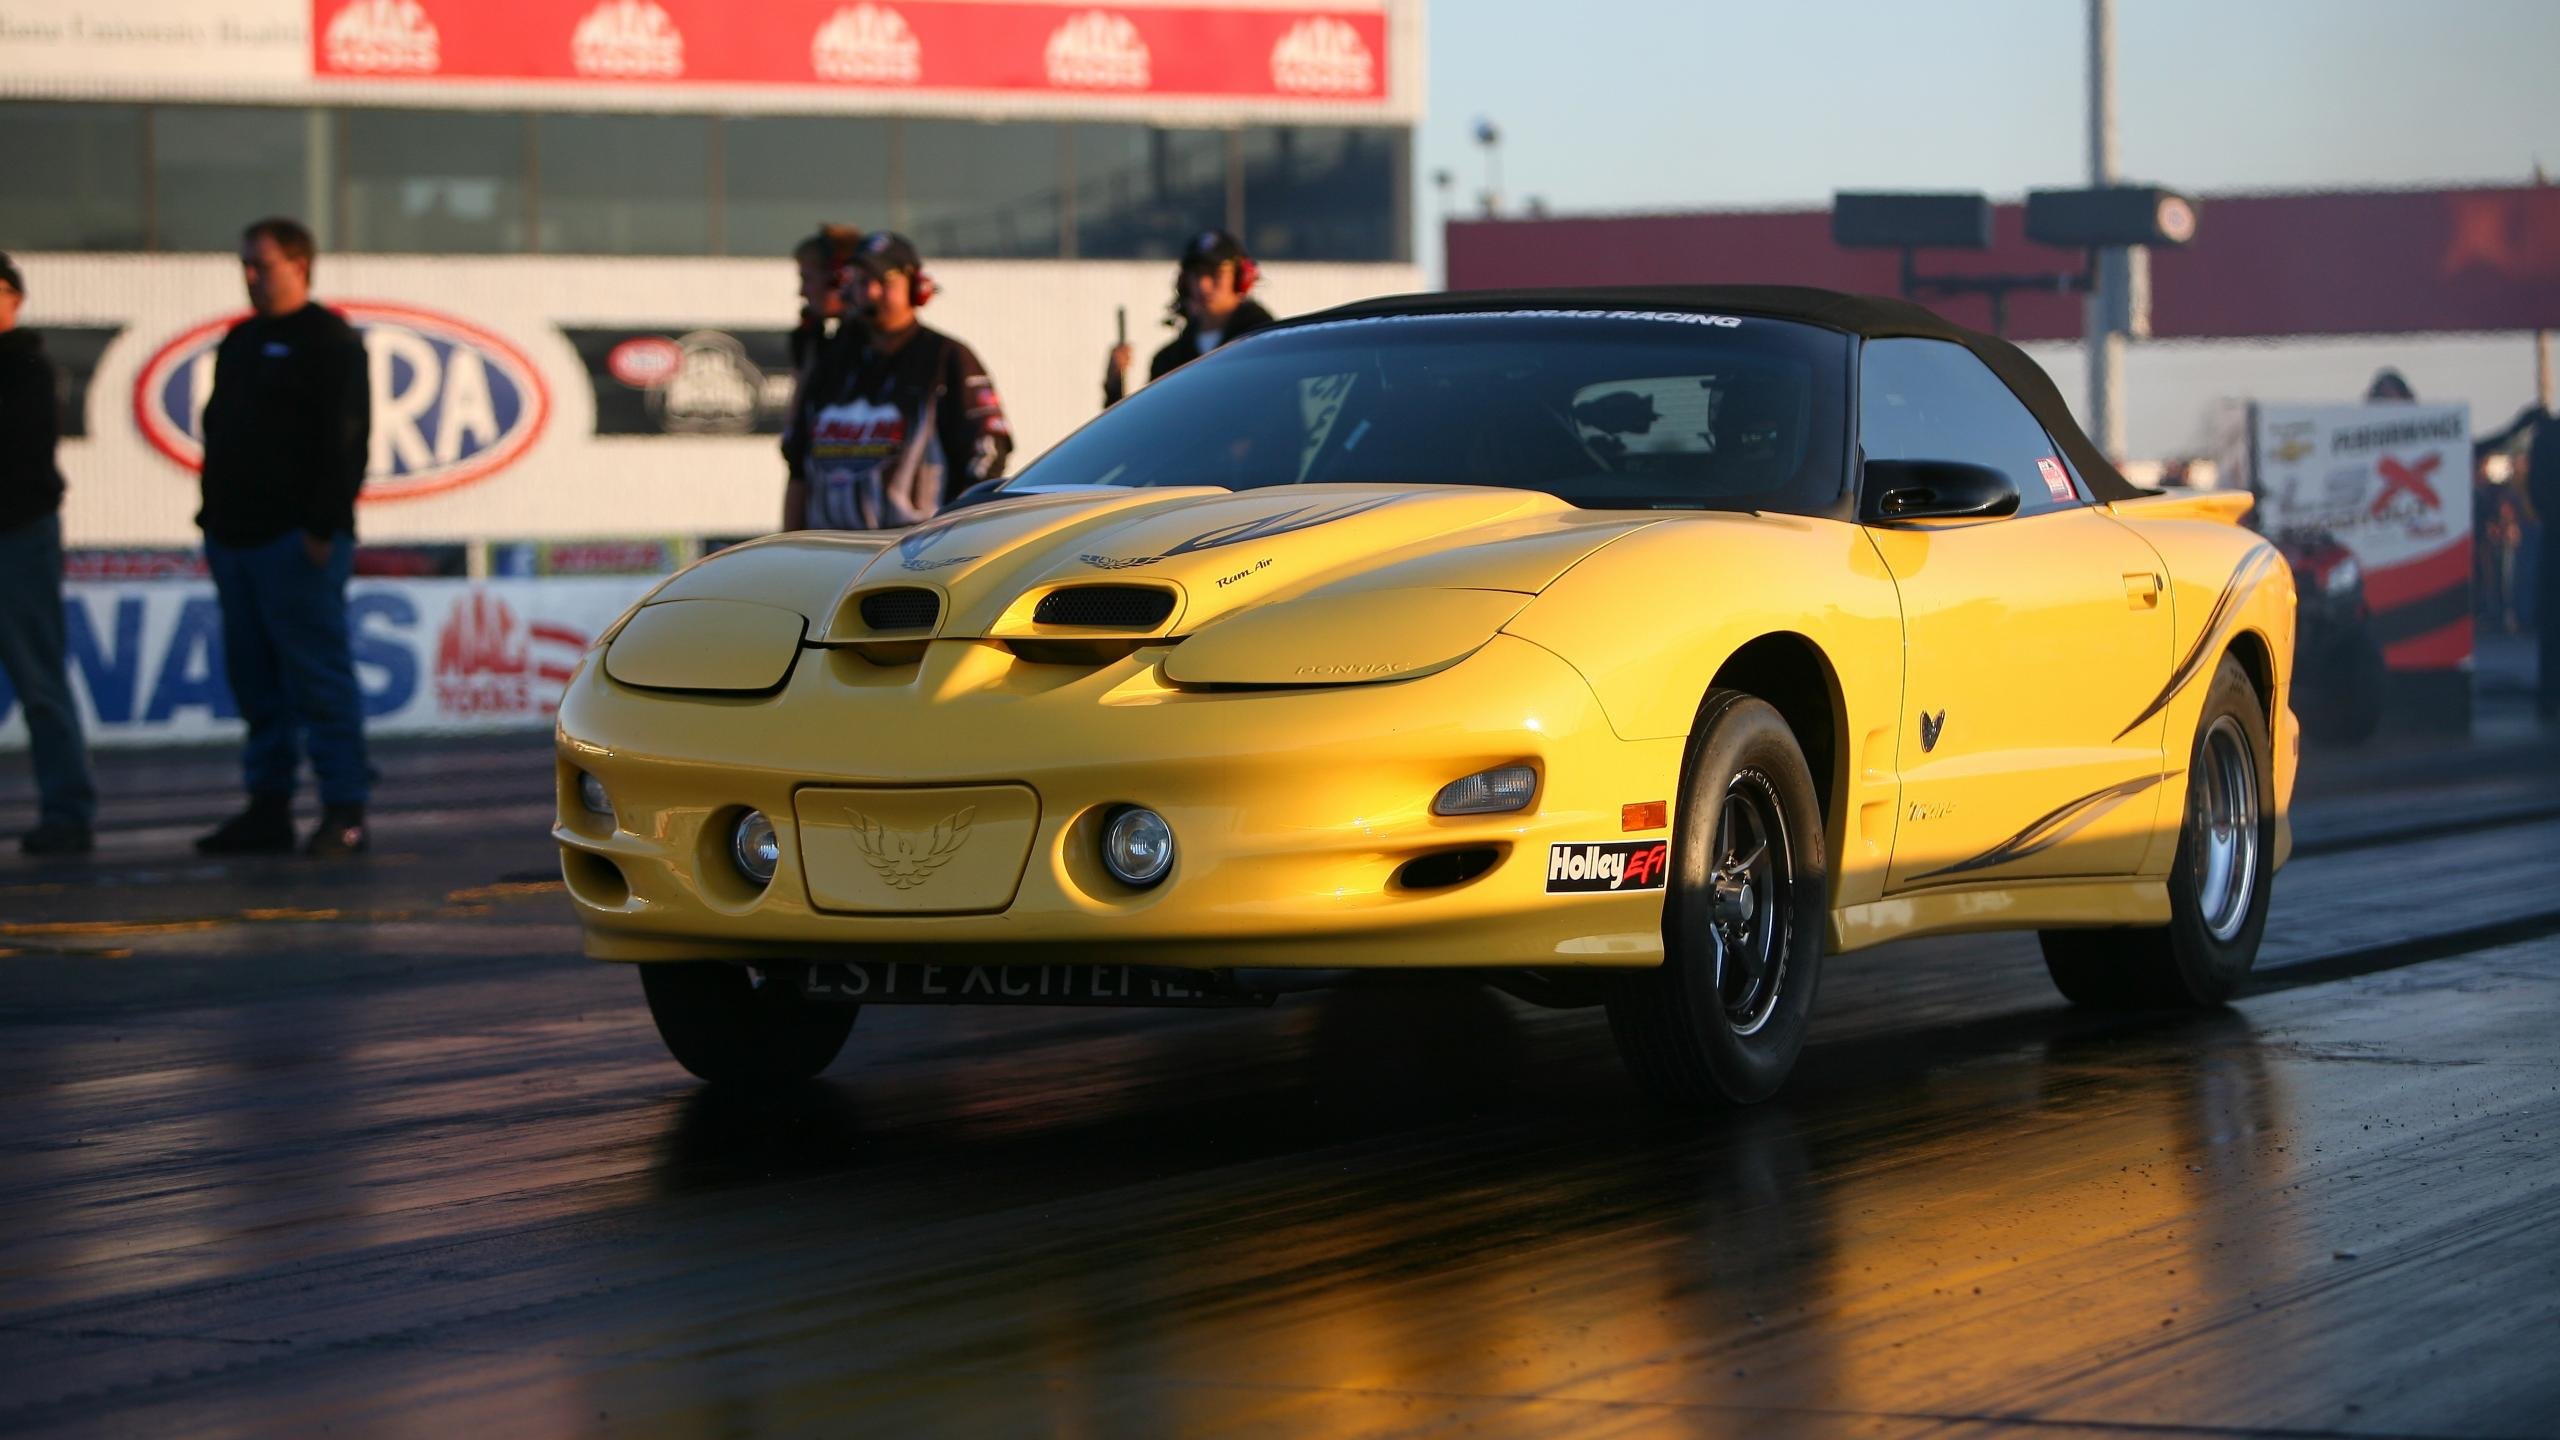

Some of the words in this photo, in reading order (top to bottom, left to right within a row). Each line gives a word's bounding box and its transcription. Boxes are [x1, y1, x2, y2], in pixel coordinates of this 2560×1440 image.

[1606, 310, 1742, 328] RACING
[1215, 569, 1255, 589] Ram
[1255, 558, 1273, 572] Air
[1294, 661, 1411, 675] PONTIAC
[1549, 845, 1627, 890] Holley
